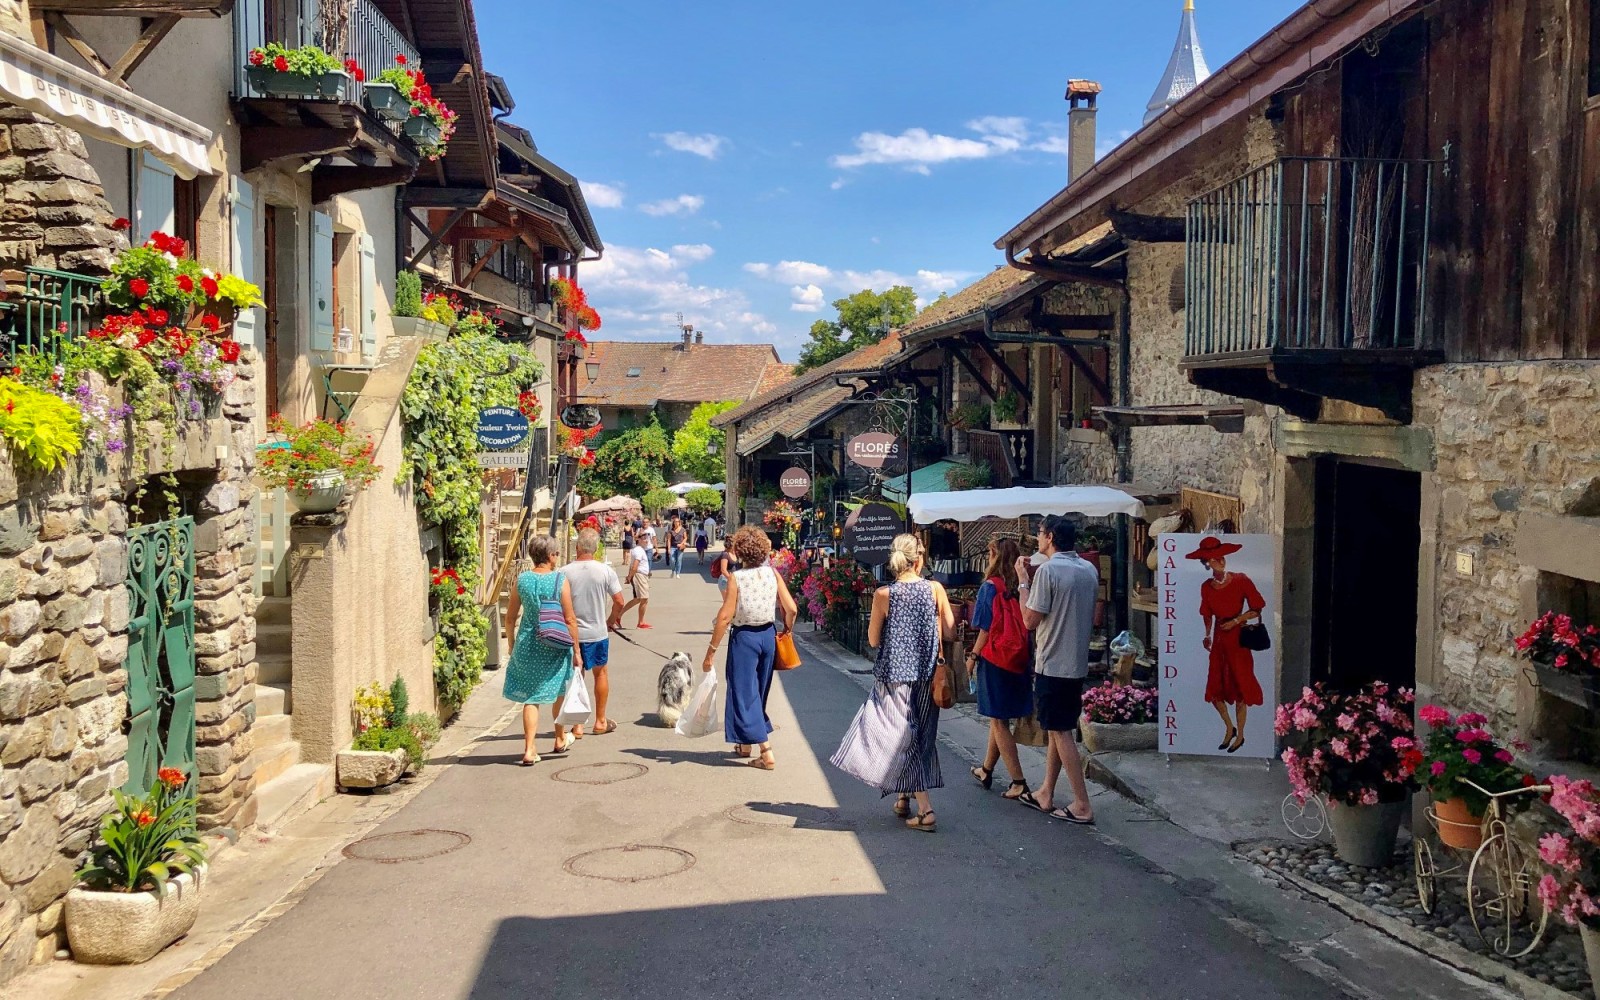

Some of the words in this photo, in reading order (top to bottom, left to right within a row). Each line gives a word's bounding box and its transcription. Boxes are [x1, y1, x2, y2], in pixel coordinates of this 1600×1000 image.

[36, 78, 95, 112] DEPUIS
[483, 408, 516, 417] PEINTURE
[505, 423, 528, 432] Yvoire
[479, 433, 522, 445] DECORATION
[480, 456, 526, 466] GALERIE
[1163, 538, 1177, 654] GALERIE
